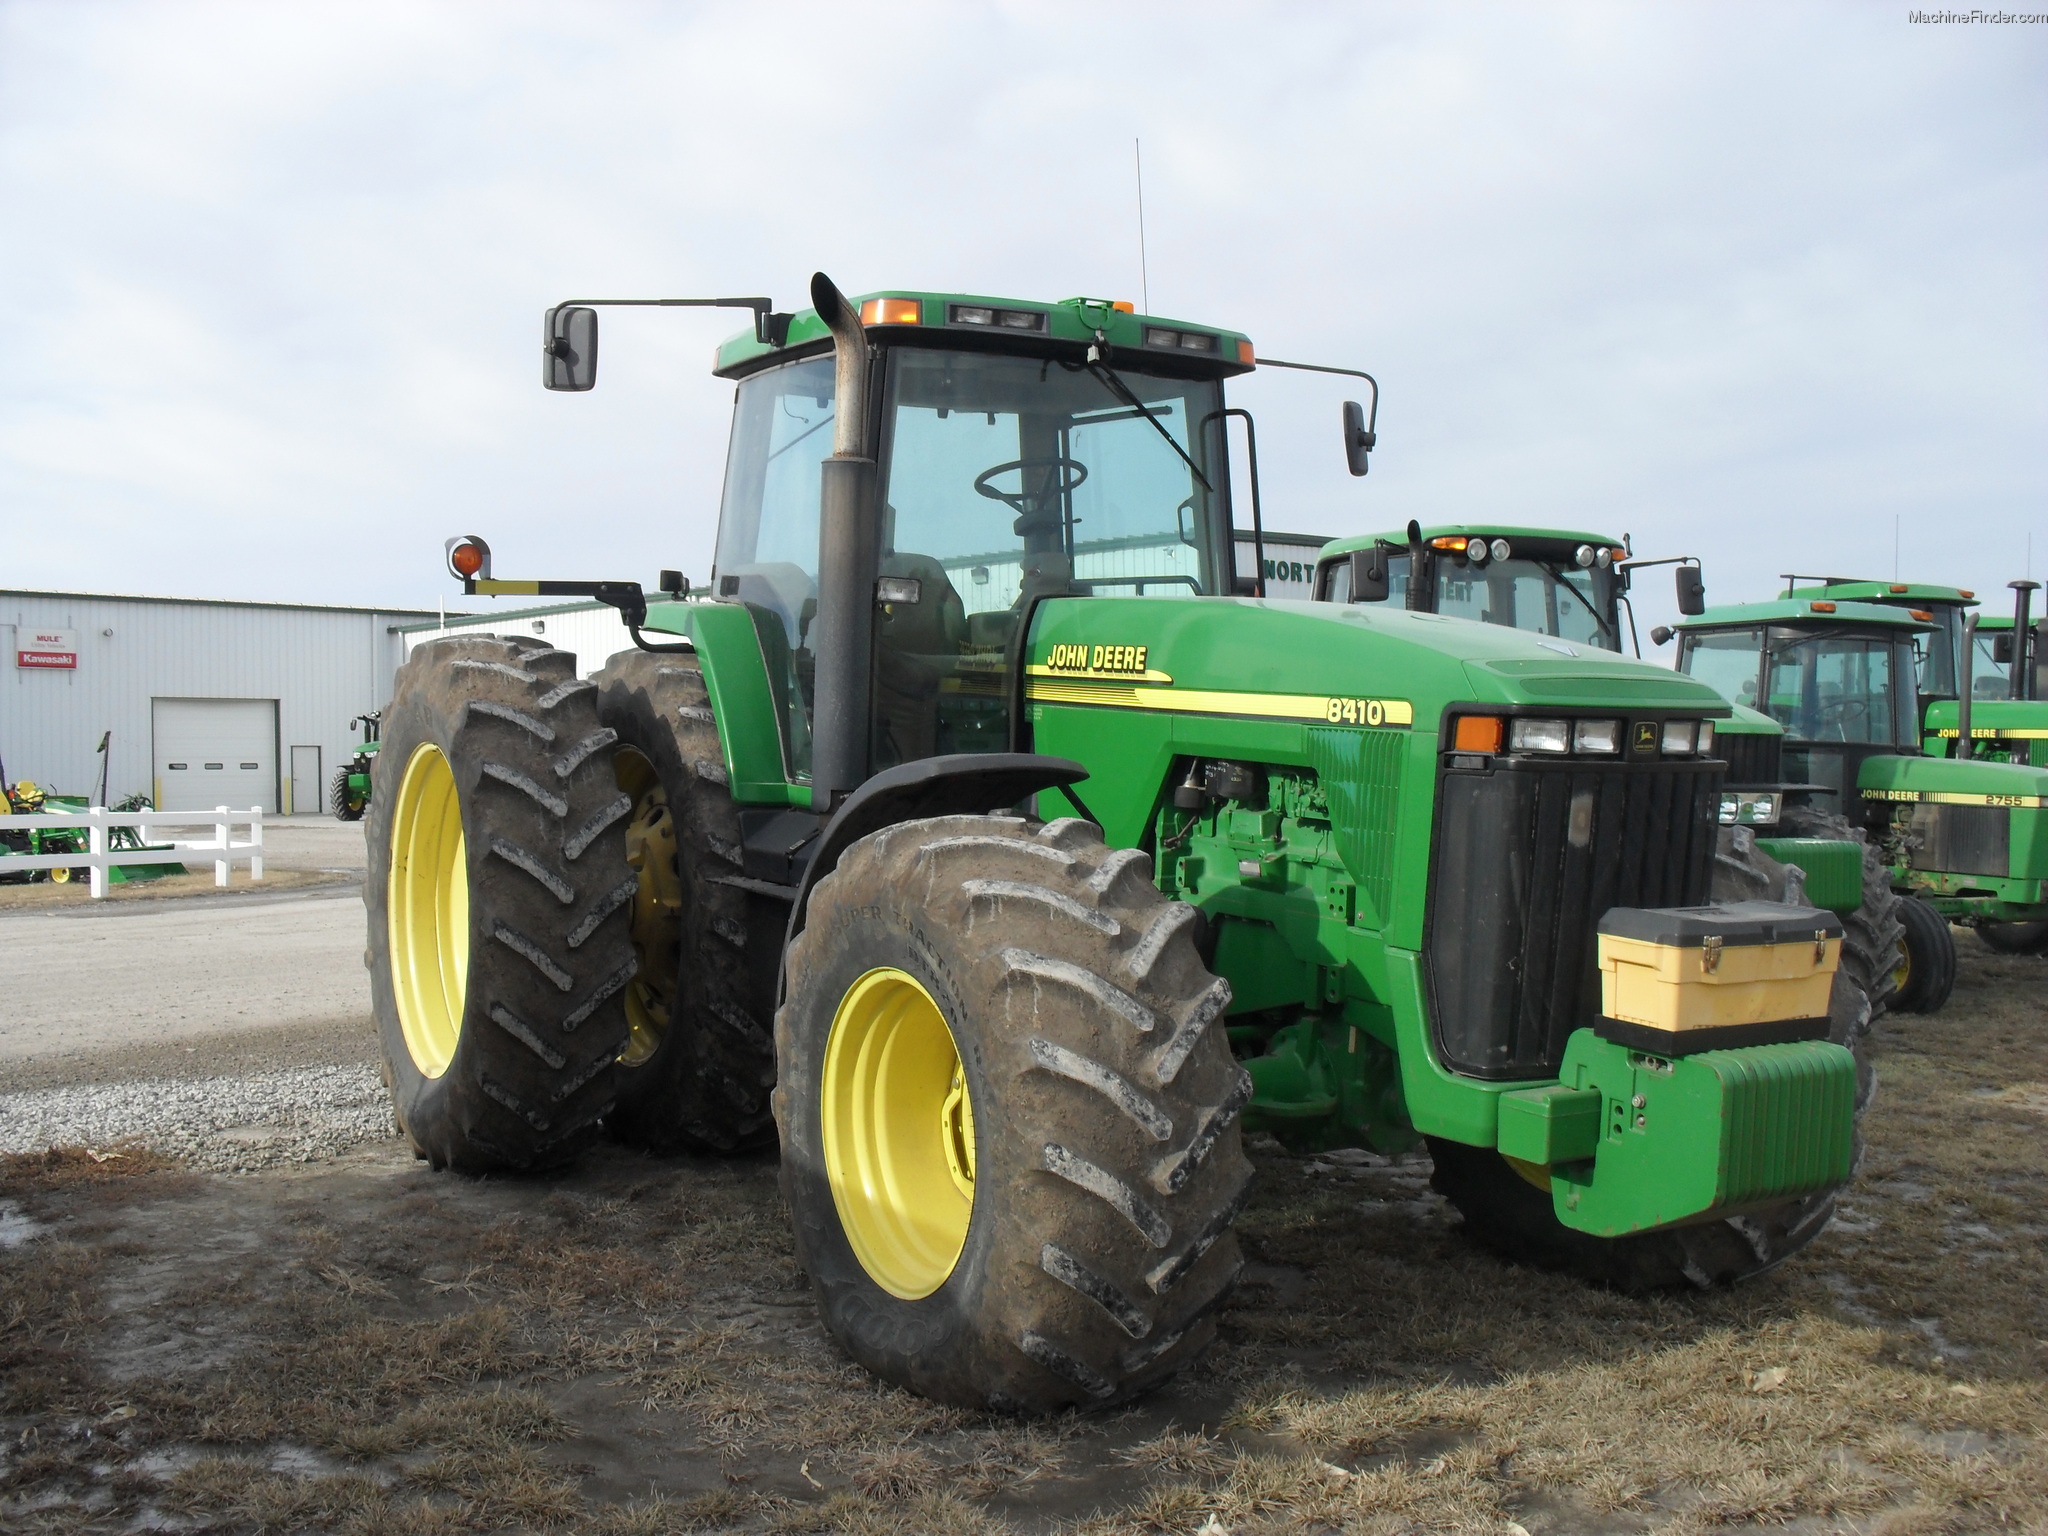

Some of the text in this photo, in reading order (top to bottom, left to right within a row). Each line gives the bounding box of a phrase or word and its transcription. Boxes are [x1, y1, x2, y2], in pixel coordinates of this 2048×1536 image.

[1263, 559, 1315, 584] NORT
[23, 653, 73, 664] Kawasaki
[1046, 643, 1147, 674] JOHN DEERE
[1327, 697, 1383, 727] 8410
[1970, 728, 1997, 738] EERE
[1860, 789, 1920, 801] JOHN DEERE
[1985, 795, 2023, 806] 2755
